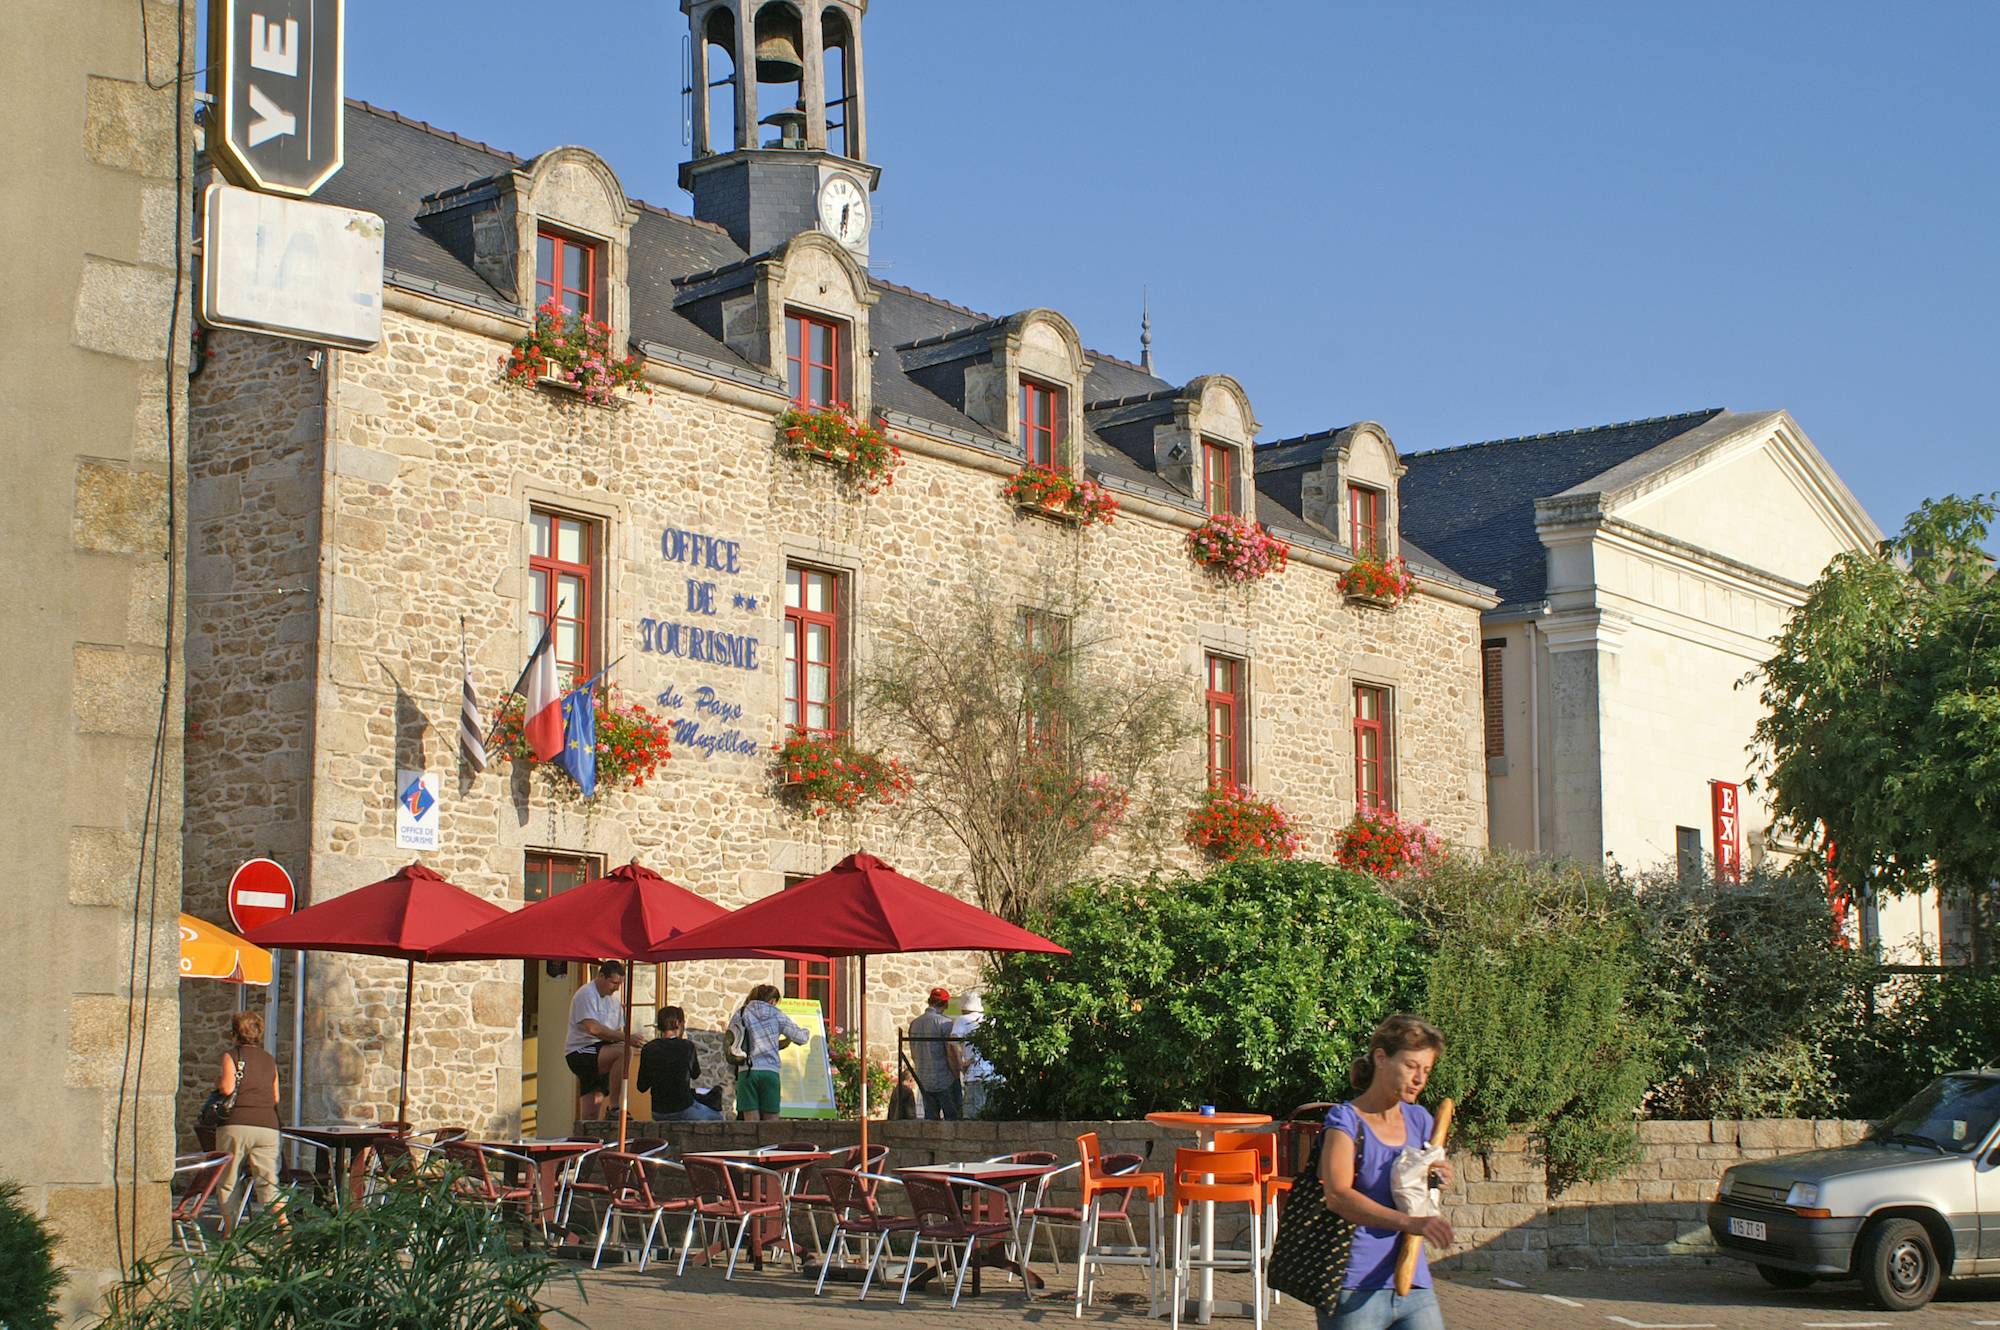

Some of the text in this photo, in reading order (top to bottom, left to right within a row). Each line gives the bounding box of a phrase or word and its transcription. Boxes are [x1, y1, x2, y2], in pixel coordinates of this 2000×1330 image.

[661, 527, 741, 574] OFFICE
[687, 578, 718, 616] DE
[640, 617, 760, 671] TOURISME
[656, 684, 683, 708] du
[694, 686, 743, 724] Pays
[673, 718, 758, 758] Muzillac
[400, 825, 434, 837] OFFICE DE
[400, 834, 434, 846] TOURISME
[1733, 1219, 1745, 1234] 115
[1755, 1223, 1764, 1238] 91
